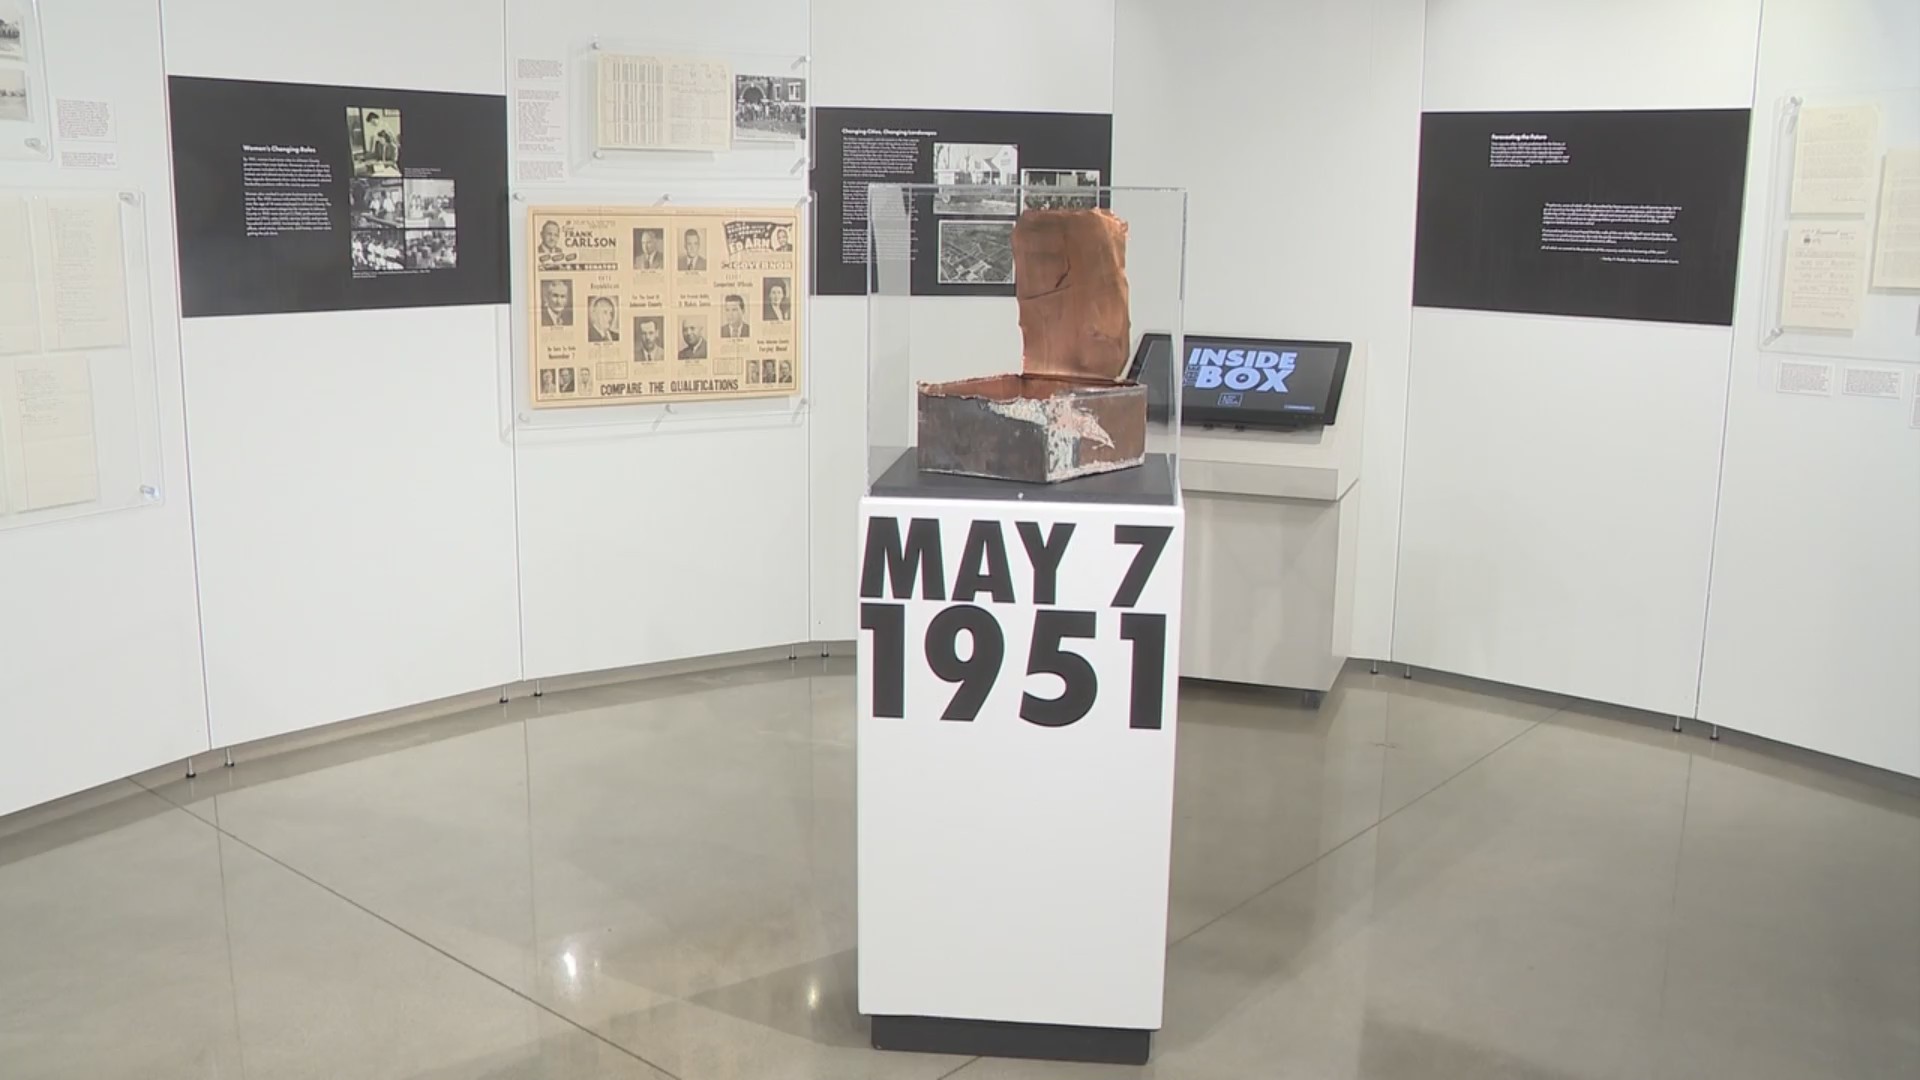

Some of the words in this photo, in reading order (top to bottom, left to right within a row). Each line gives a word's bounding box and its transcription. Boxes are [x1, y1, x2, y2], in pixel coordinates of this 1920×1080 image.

[243, 144, 271, 152] Women's
[271, 145, 300, 154] Changing
[564, 238, 616, 247] CARLSON
[1188, 348, 1297, 369] INSIDE
[600, 382, 643, 396] COMPARE
[649, 381, 665, 394] THE
[670, 379, 739, 393] QUALIFICATIONS
[1195, 365, 1295, 393] BOX
[860, 516, 1077, 605] MAY
[1110, 524, 1174, 608] 7
[860, 602, 1167, 730] 1951
